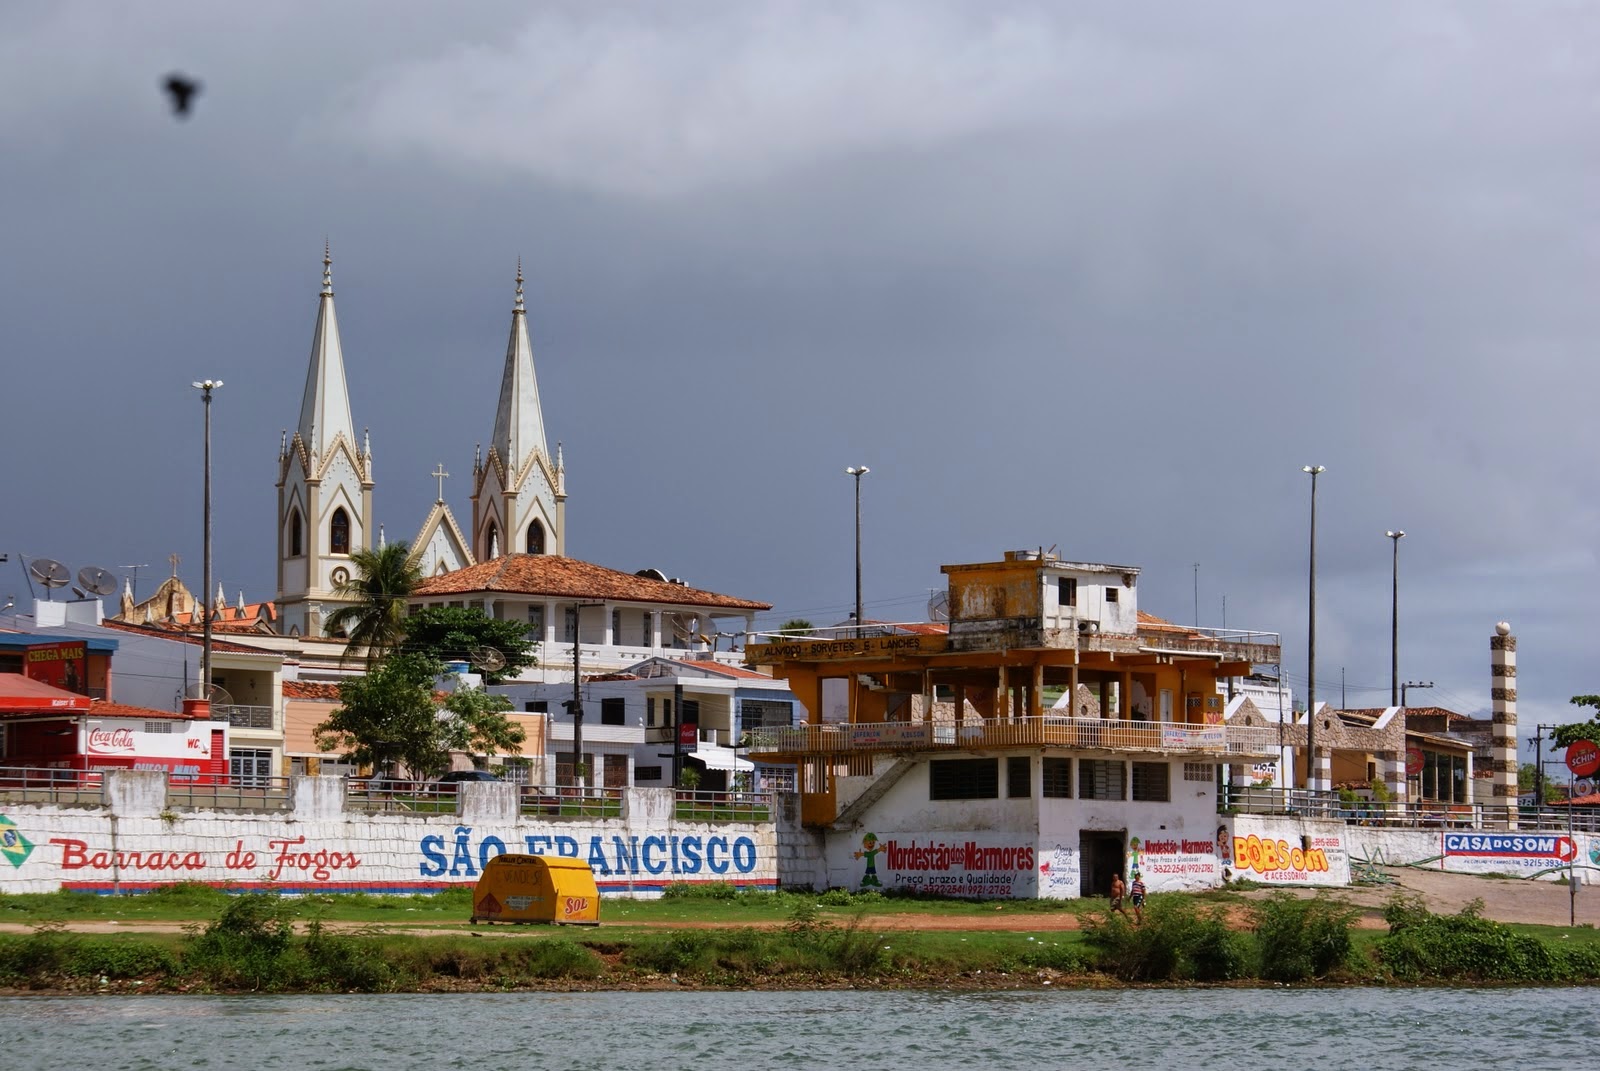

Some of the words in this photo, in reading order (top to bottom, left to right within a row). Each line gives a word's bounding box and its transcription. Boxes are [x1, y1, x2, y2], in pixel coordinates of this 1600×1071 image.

[811, 642, 855, 654] SORVETES
[880, 638, 920, 650] LANCHES
[28, 649, 59, 662] CHEGA
[60, 648, 84, 660] MAIS
[88, 727, 134, 748] Coca-Cola
[1571, 752, 1597, 767] SCHIN
[420, 826, 508, 877] SÃO
[1145, 838, 1177, 855] Nordestão
[1181, 838, 1214, 855] Marmores
[1447, 836, 1492, 851] CASA
[1512, 838, 1555, 852] SOM
[50, 838, 207, 871] Barraca
[225, 840, 257, 870] de
[268, 835, 361, 881] Fogos
[887, 840, 950, 871] Nordestão
[964, 841, 1034, 871] Marmores
[929, 875, 957, 885] prazo
[958, 876, 964, 884] e
[565, 897, 588, 914] SOL
